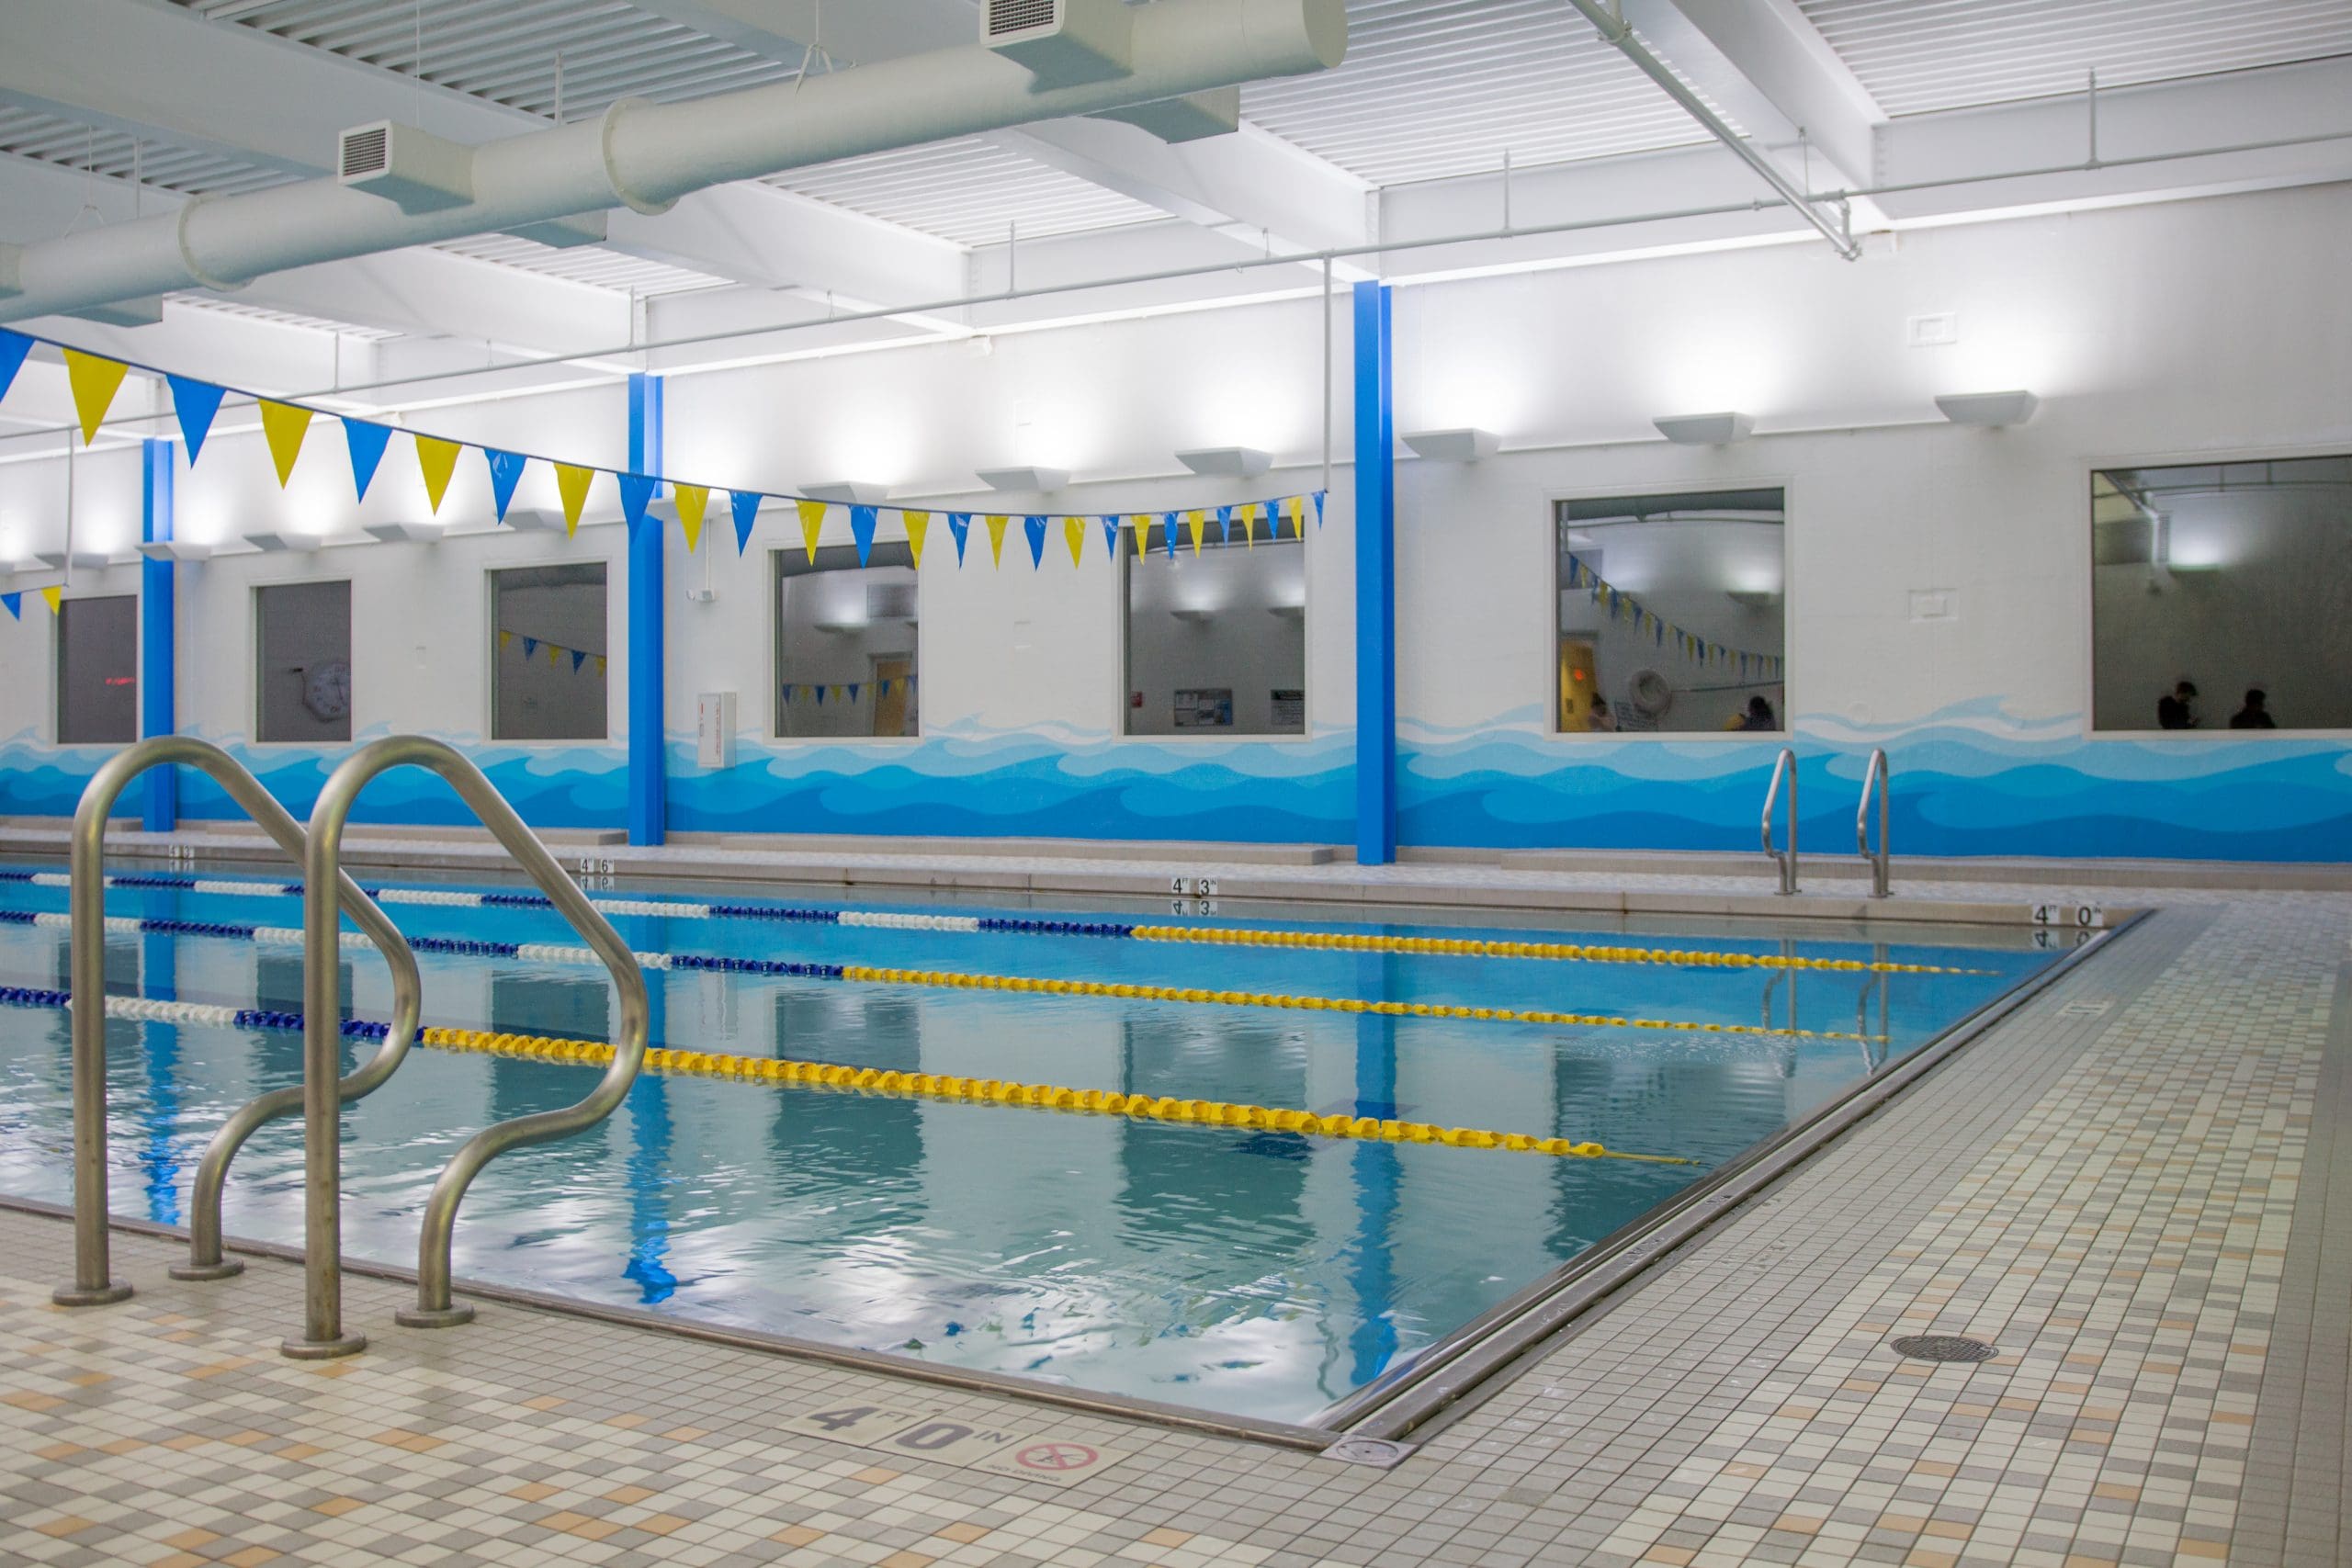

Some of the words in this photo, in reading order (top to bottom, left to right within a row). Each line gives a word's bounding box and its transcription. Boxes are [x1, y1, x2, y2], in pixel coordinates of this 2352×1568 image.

[582, 858, 588, 873] 4
[602, 859, 608, 873] 6
[1172, 878, 1182, 894] 4
[1200, 879, 1209, 895] 3
[2034, 905, 2048, 925] 4
[2078, 907, 2091, 926] 0
[807, 1406, 882, 1431] 4
[876, 1411, 917, 1423] FT
[895, 1423, 974, 1450] 0
[973, 1429, 1013, 1444] IN
